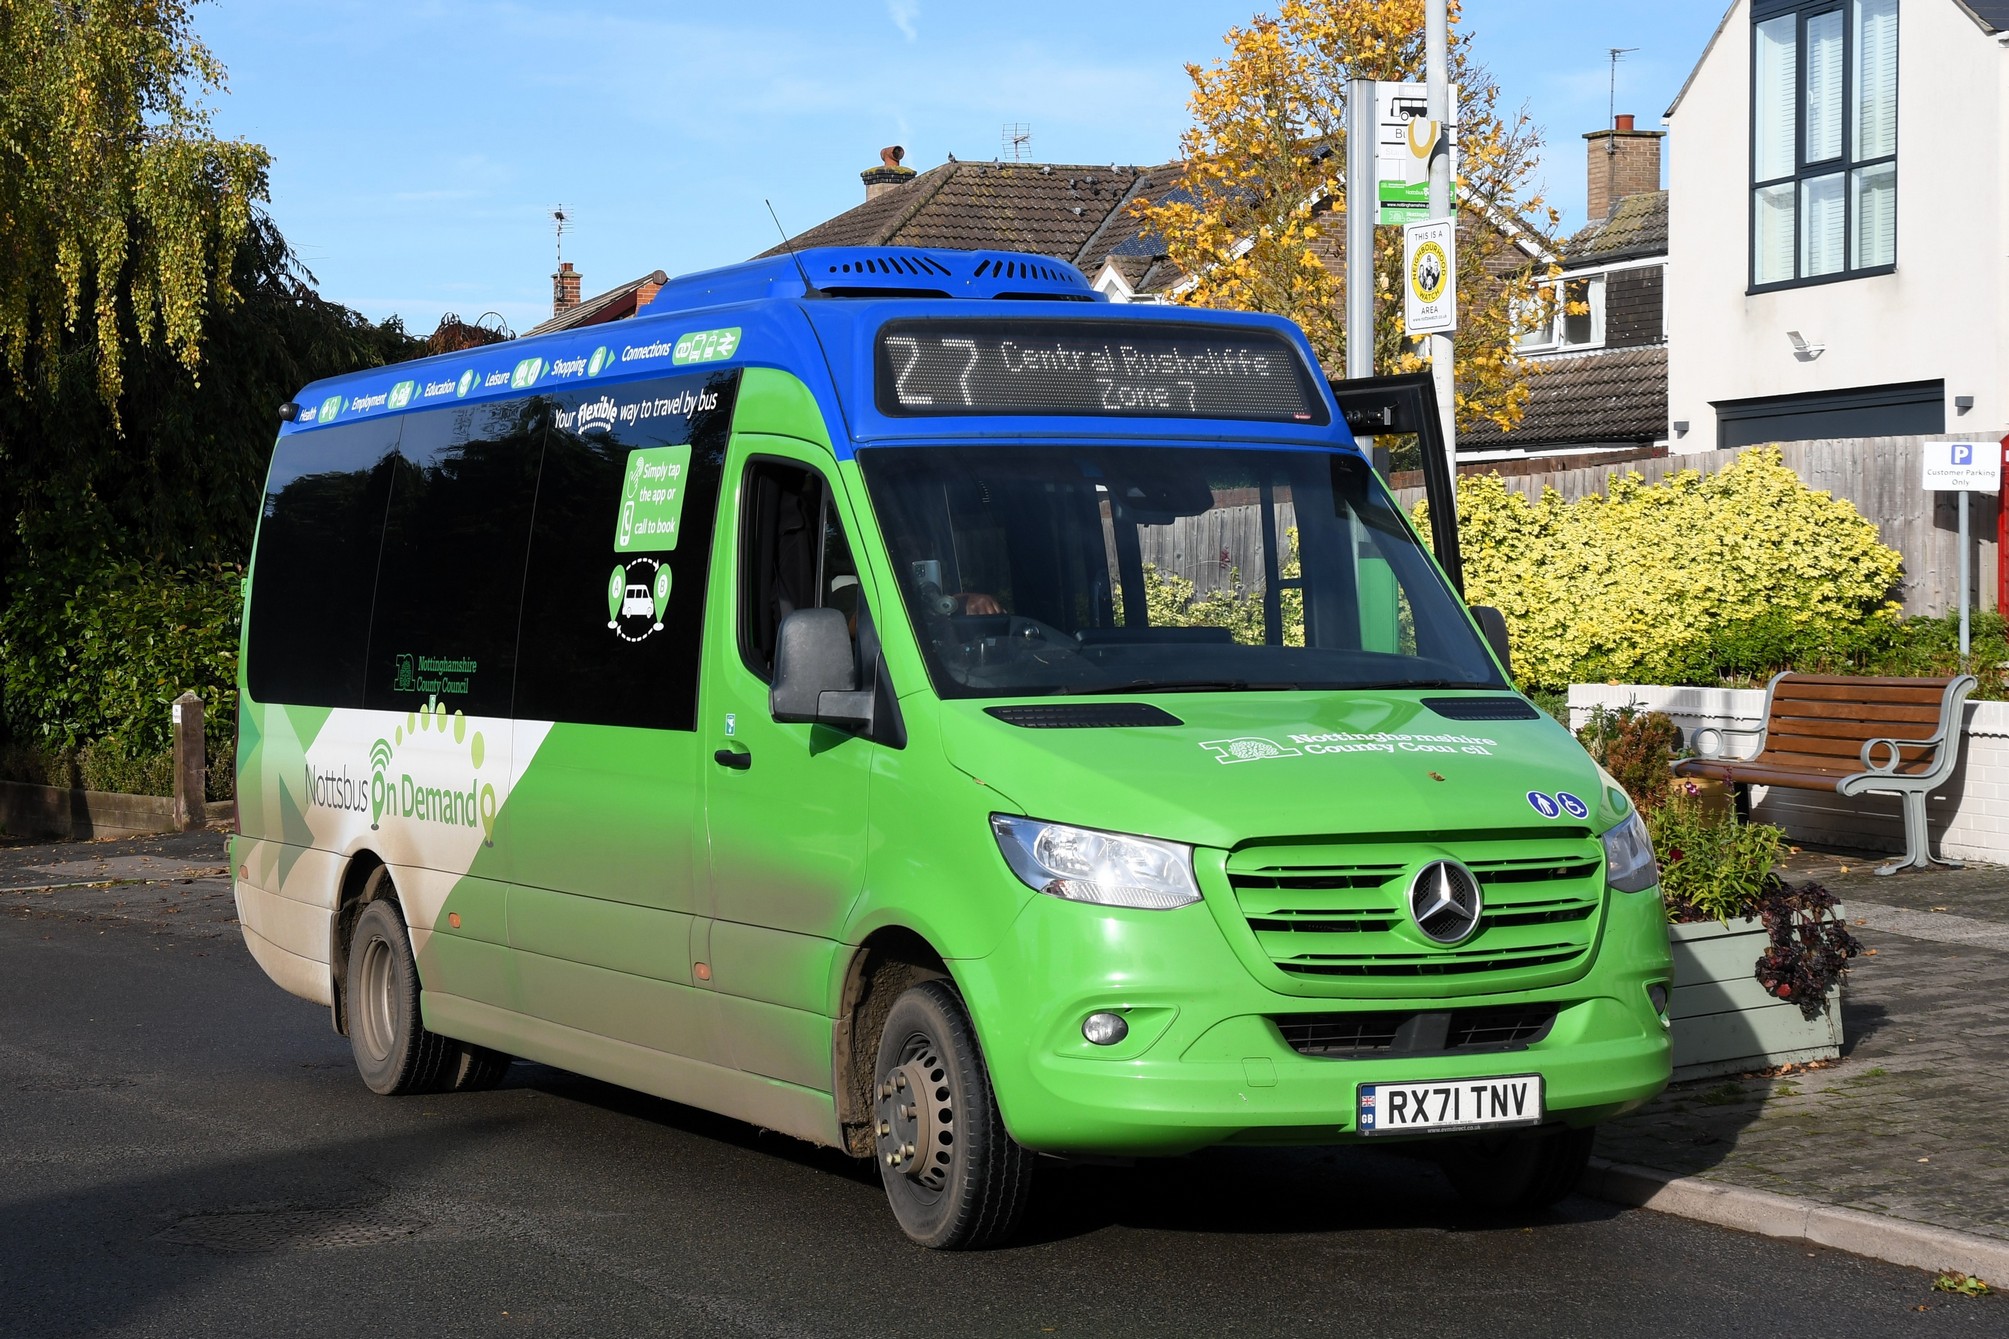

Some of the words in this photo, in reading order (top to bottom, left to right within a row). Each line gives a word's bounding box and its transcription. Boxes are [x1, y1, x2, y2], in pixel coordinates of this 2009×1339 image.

[1414, 231, 1429, 241] THIS
[1430, 230, 1437, 239] IS
[1412, 243, 1447, 280] NEIGHBOURHOOD
[1419, 289, 1440, 301] WATCH
[1421, 306, 1439, 315] AREA
[1001, 341, 1116, 372] Central
[1120, 346, 1271, 376] Rushcliffe
[299, 406, 317, 422] Health
[351, 392, 388, 412] Employment
[424, 379, 456, 397] Education
[484, 370, 511, 387] Leisure
[551, 356, 588, 378] Shopping
[621, 340, 672, 362] Connections
[1096, 379, 1170, 409] Zone
[1178, 381, 1196, 411] 7
[554, 408, 575, 429] Your
[577, 395, 617, 426] flexible
[619, 401, 641, 426] way
[640, 399, 652, 416] to
[652, 390, 681, 415] travel
[680, 390, 698, 419] by
[697, 388, 718, 411] bus
[642, 462, 667, 481] Simply
[666, 464, 681, 480] tap
[1965, 469, 1996, 478] Parking
[1951, 479, 1970, 487] Only
[640, 487, 652, 501] the
[652, 489, 667, 503] app
[666, 487, 677, 500] or
[634, 520, 648, 535] call
[647, 521, 656, 534] to
[656, 517, 676, 534] book
[418, 655, 478, 676] Nottinghamshire
[416, 676, 441, 695] County
[442, 677, 469, 694] Council
[1287, 731, 1498, 747] Nottinghamshire
[1304, 742, 1395, 754] County
[305, 763, 369, 812] Nottsbus
[401, 773, 478, 828] Demand
[1388, 1087, 1460, 1125] RX71
[1470, 1082, 1528, 1119] TNV
[1361, 1114, 1374, 1124] GB
